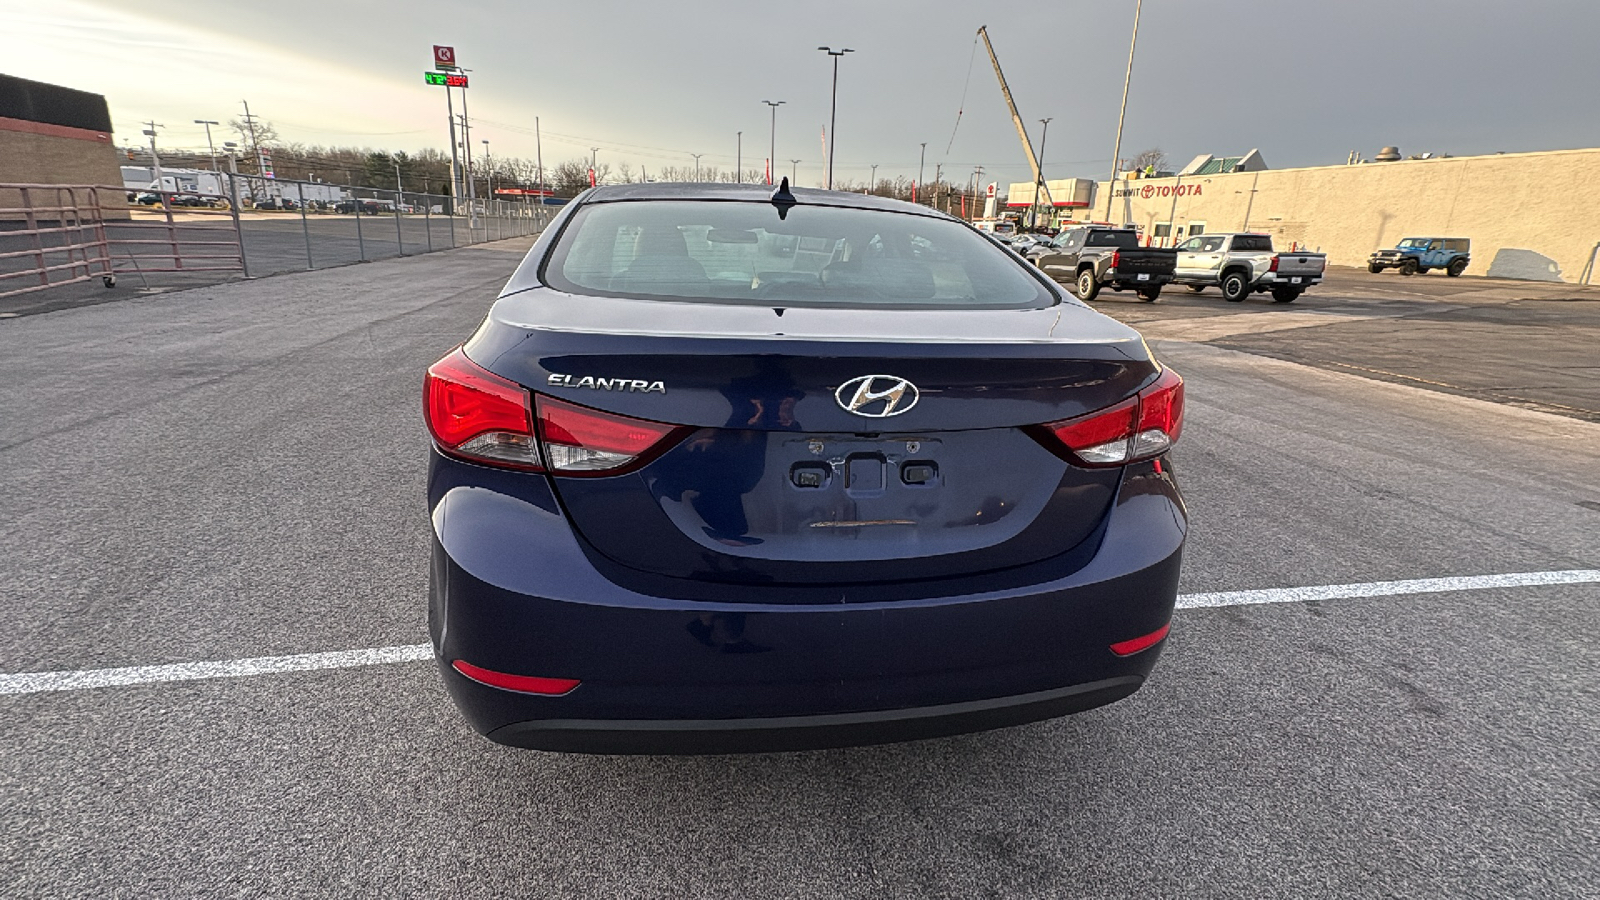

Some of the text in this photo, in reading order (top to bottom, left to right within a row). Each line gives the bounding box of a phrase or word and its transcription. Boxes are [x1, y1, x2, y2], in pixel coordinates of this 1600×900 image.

[1115, 184, 1202, 198] SUMMIT TOYOTA
[547, 373, 667, 394] ELANTRA
